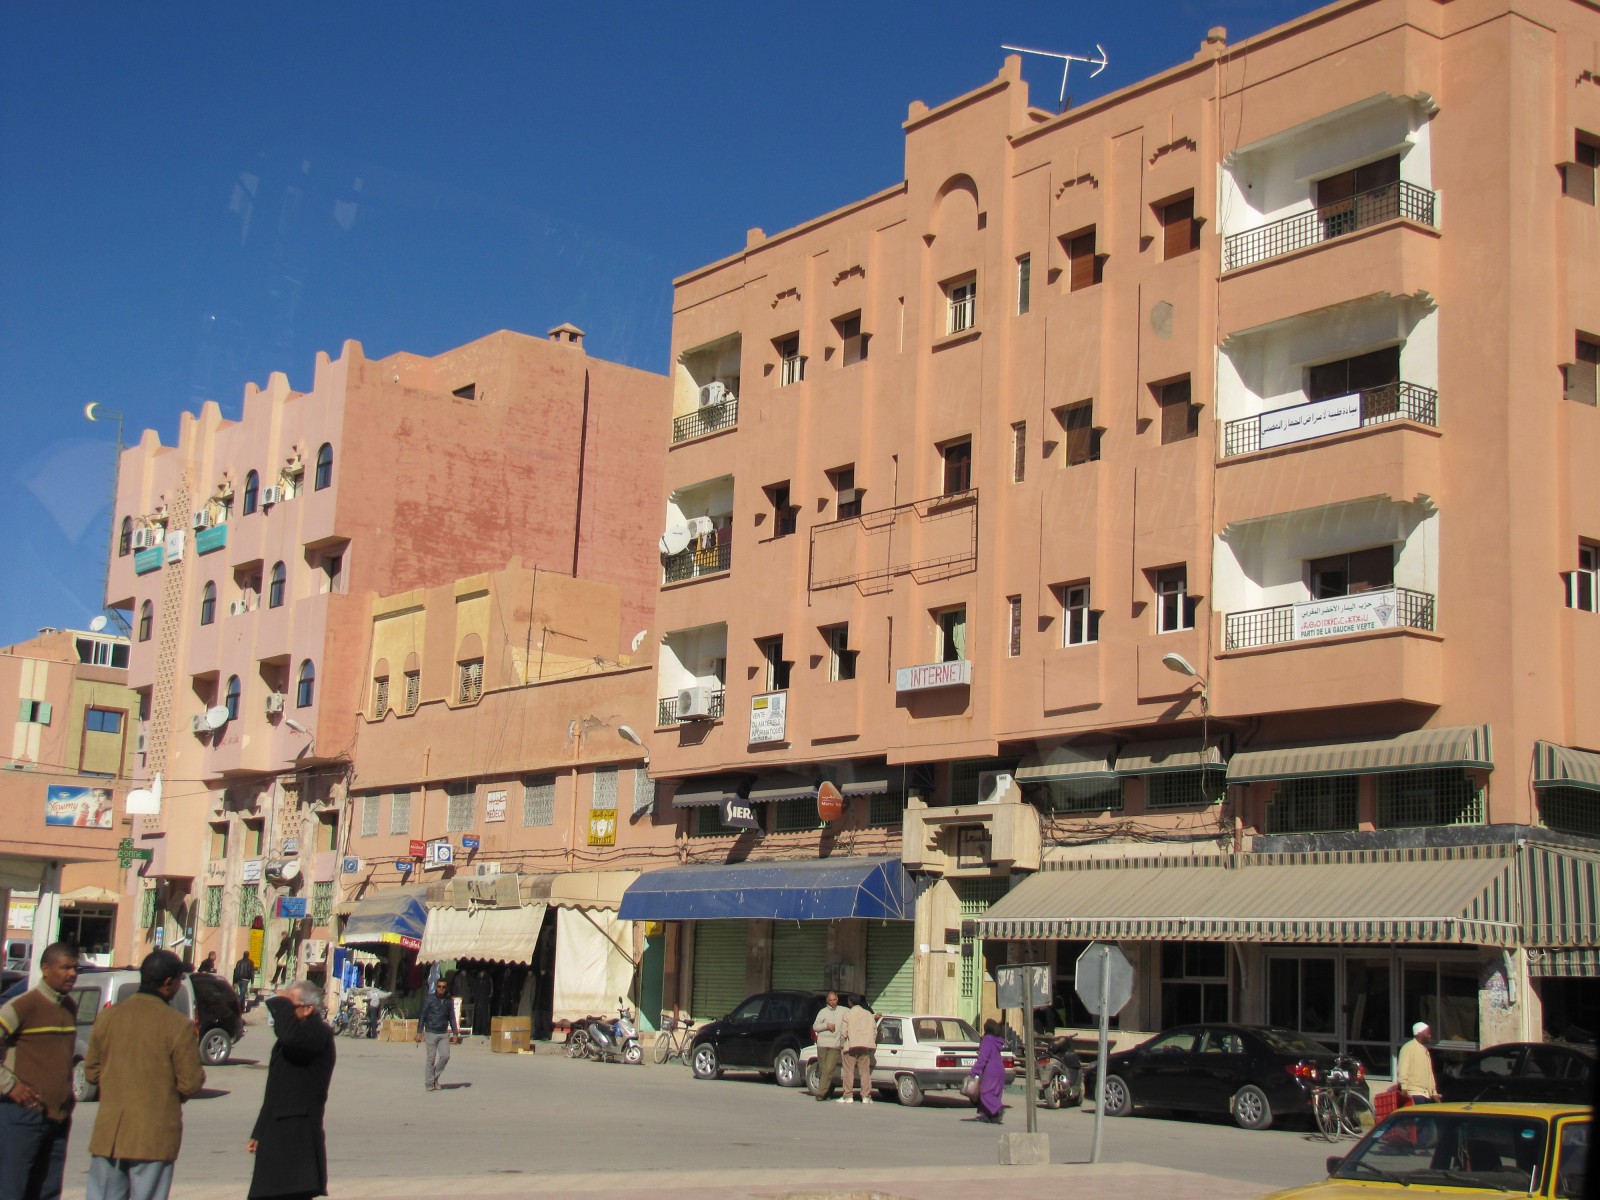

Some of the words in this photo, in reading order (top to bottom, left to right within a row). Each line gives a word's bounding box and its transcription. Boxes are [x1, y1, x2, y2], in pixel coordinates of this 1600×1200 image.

[1300, 629, 1315, 638] PARTI
[1332, 624, 1355, 633] GAUCHE
[1356, 621, 1375, 630] VERTE
[910, 662, 962, 688] INTERNET
[752, 711, 766, 720] VENTE
